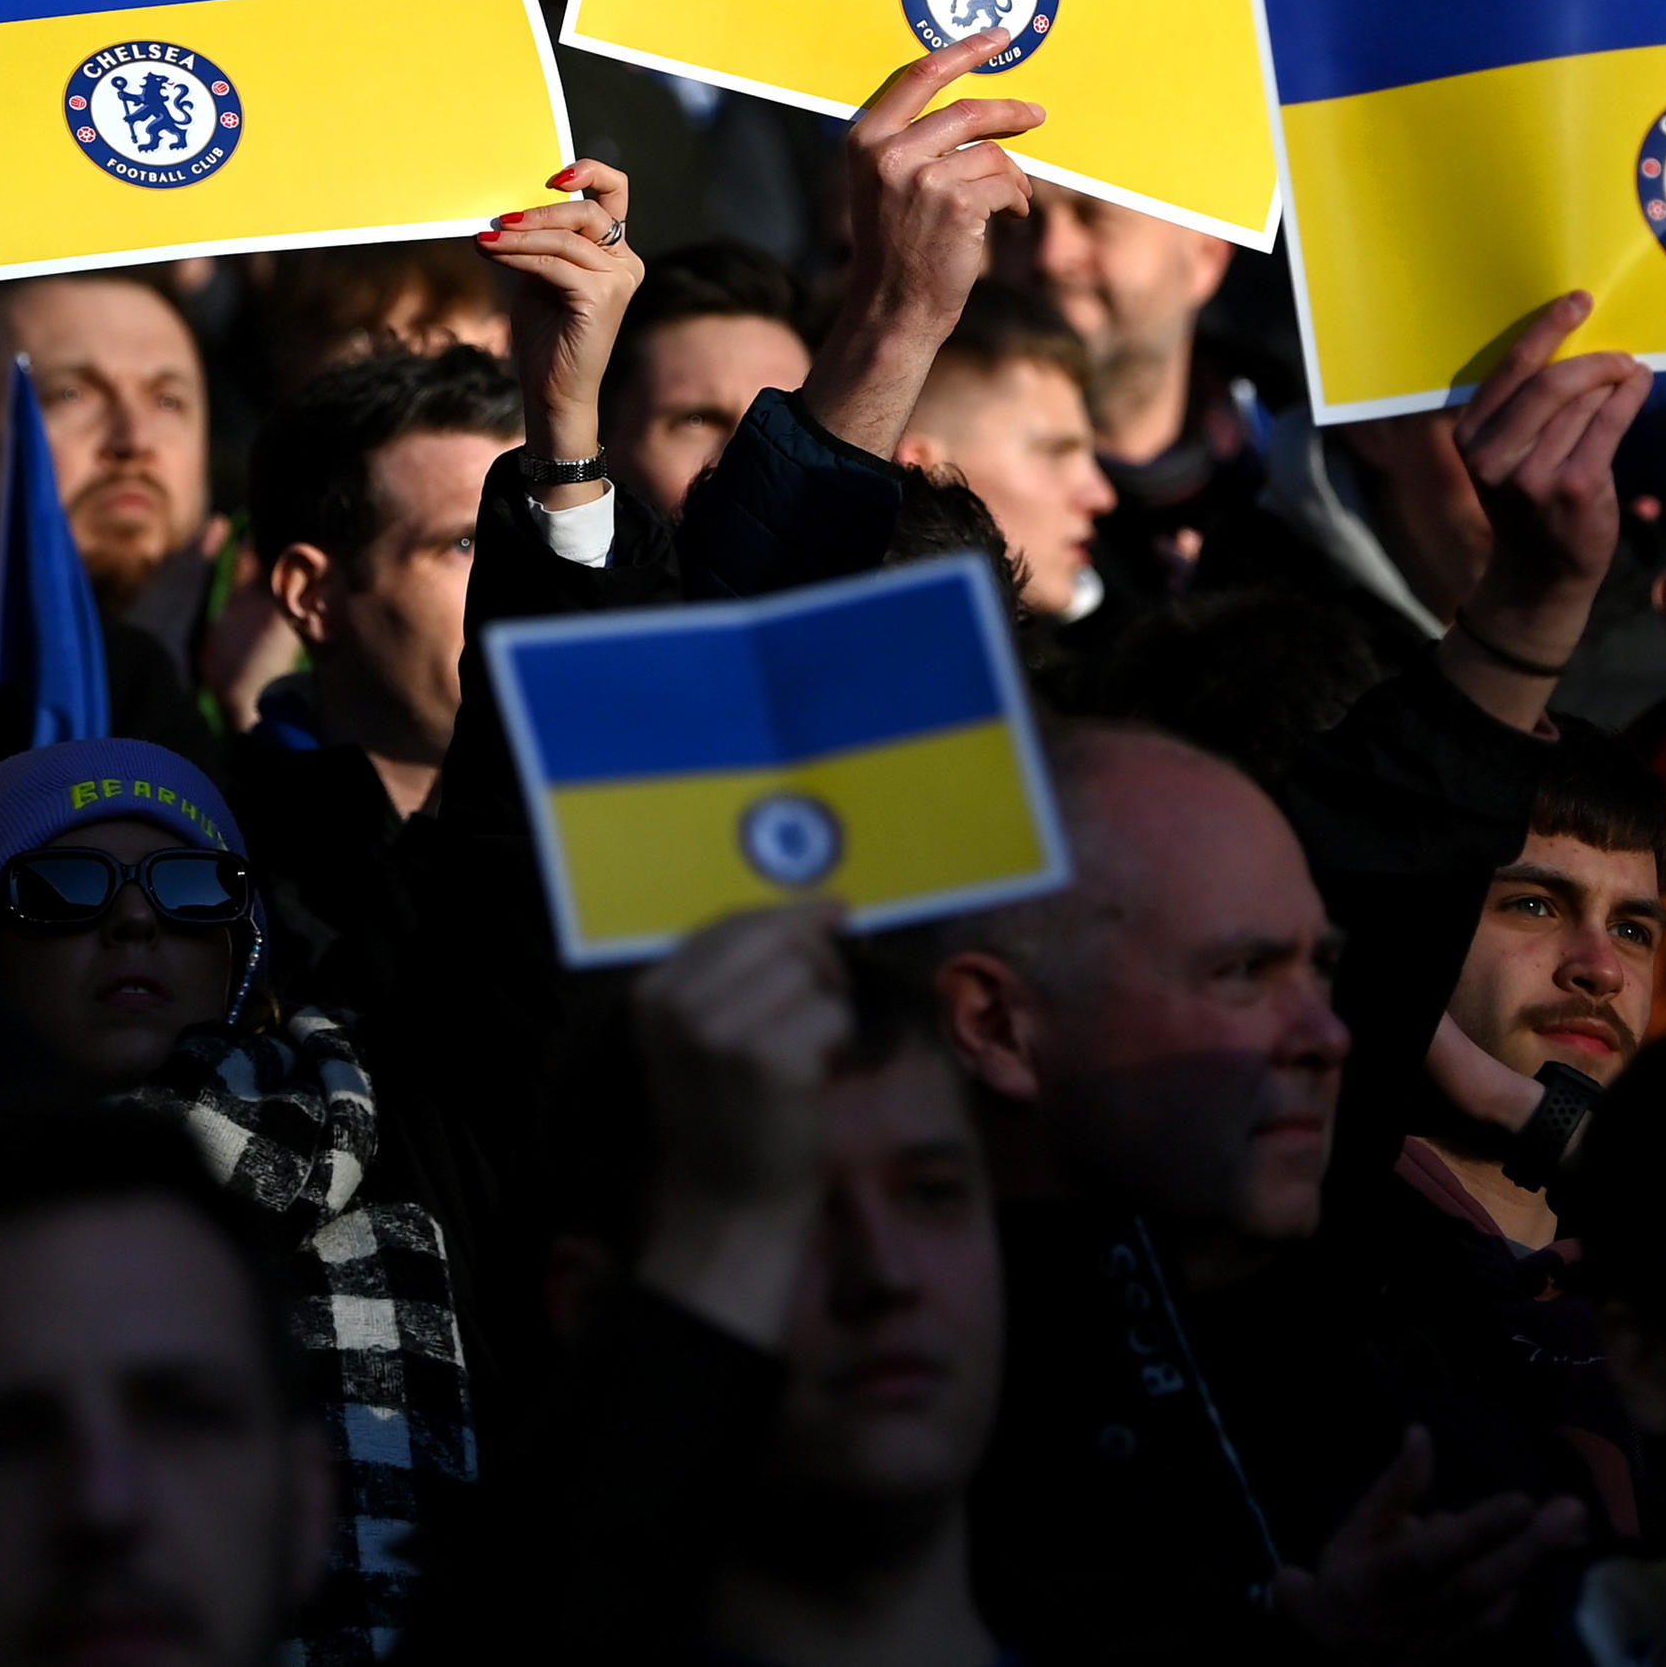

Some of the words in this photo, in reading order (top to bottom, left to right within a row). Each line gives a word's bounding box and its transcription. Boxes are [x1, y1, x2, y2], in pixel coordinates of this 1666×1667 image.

[83, 44, 195, 78] CHELSEA
[988, 46, 1023, 67] CLUB
[107, 158, 186, 183] FOOTBALL
[191, 147, 224, 174] CLUB
